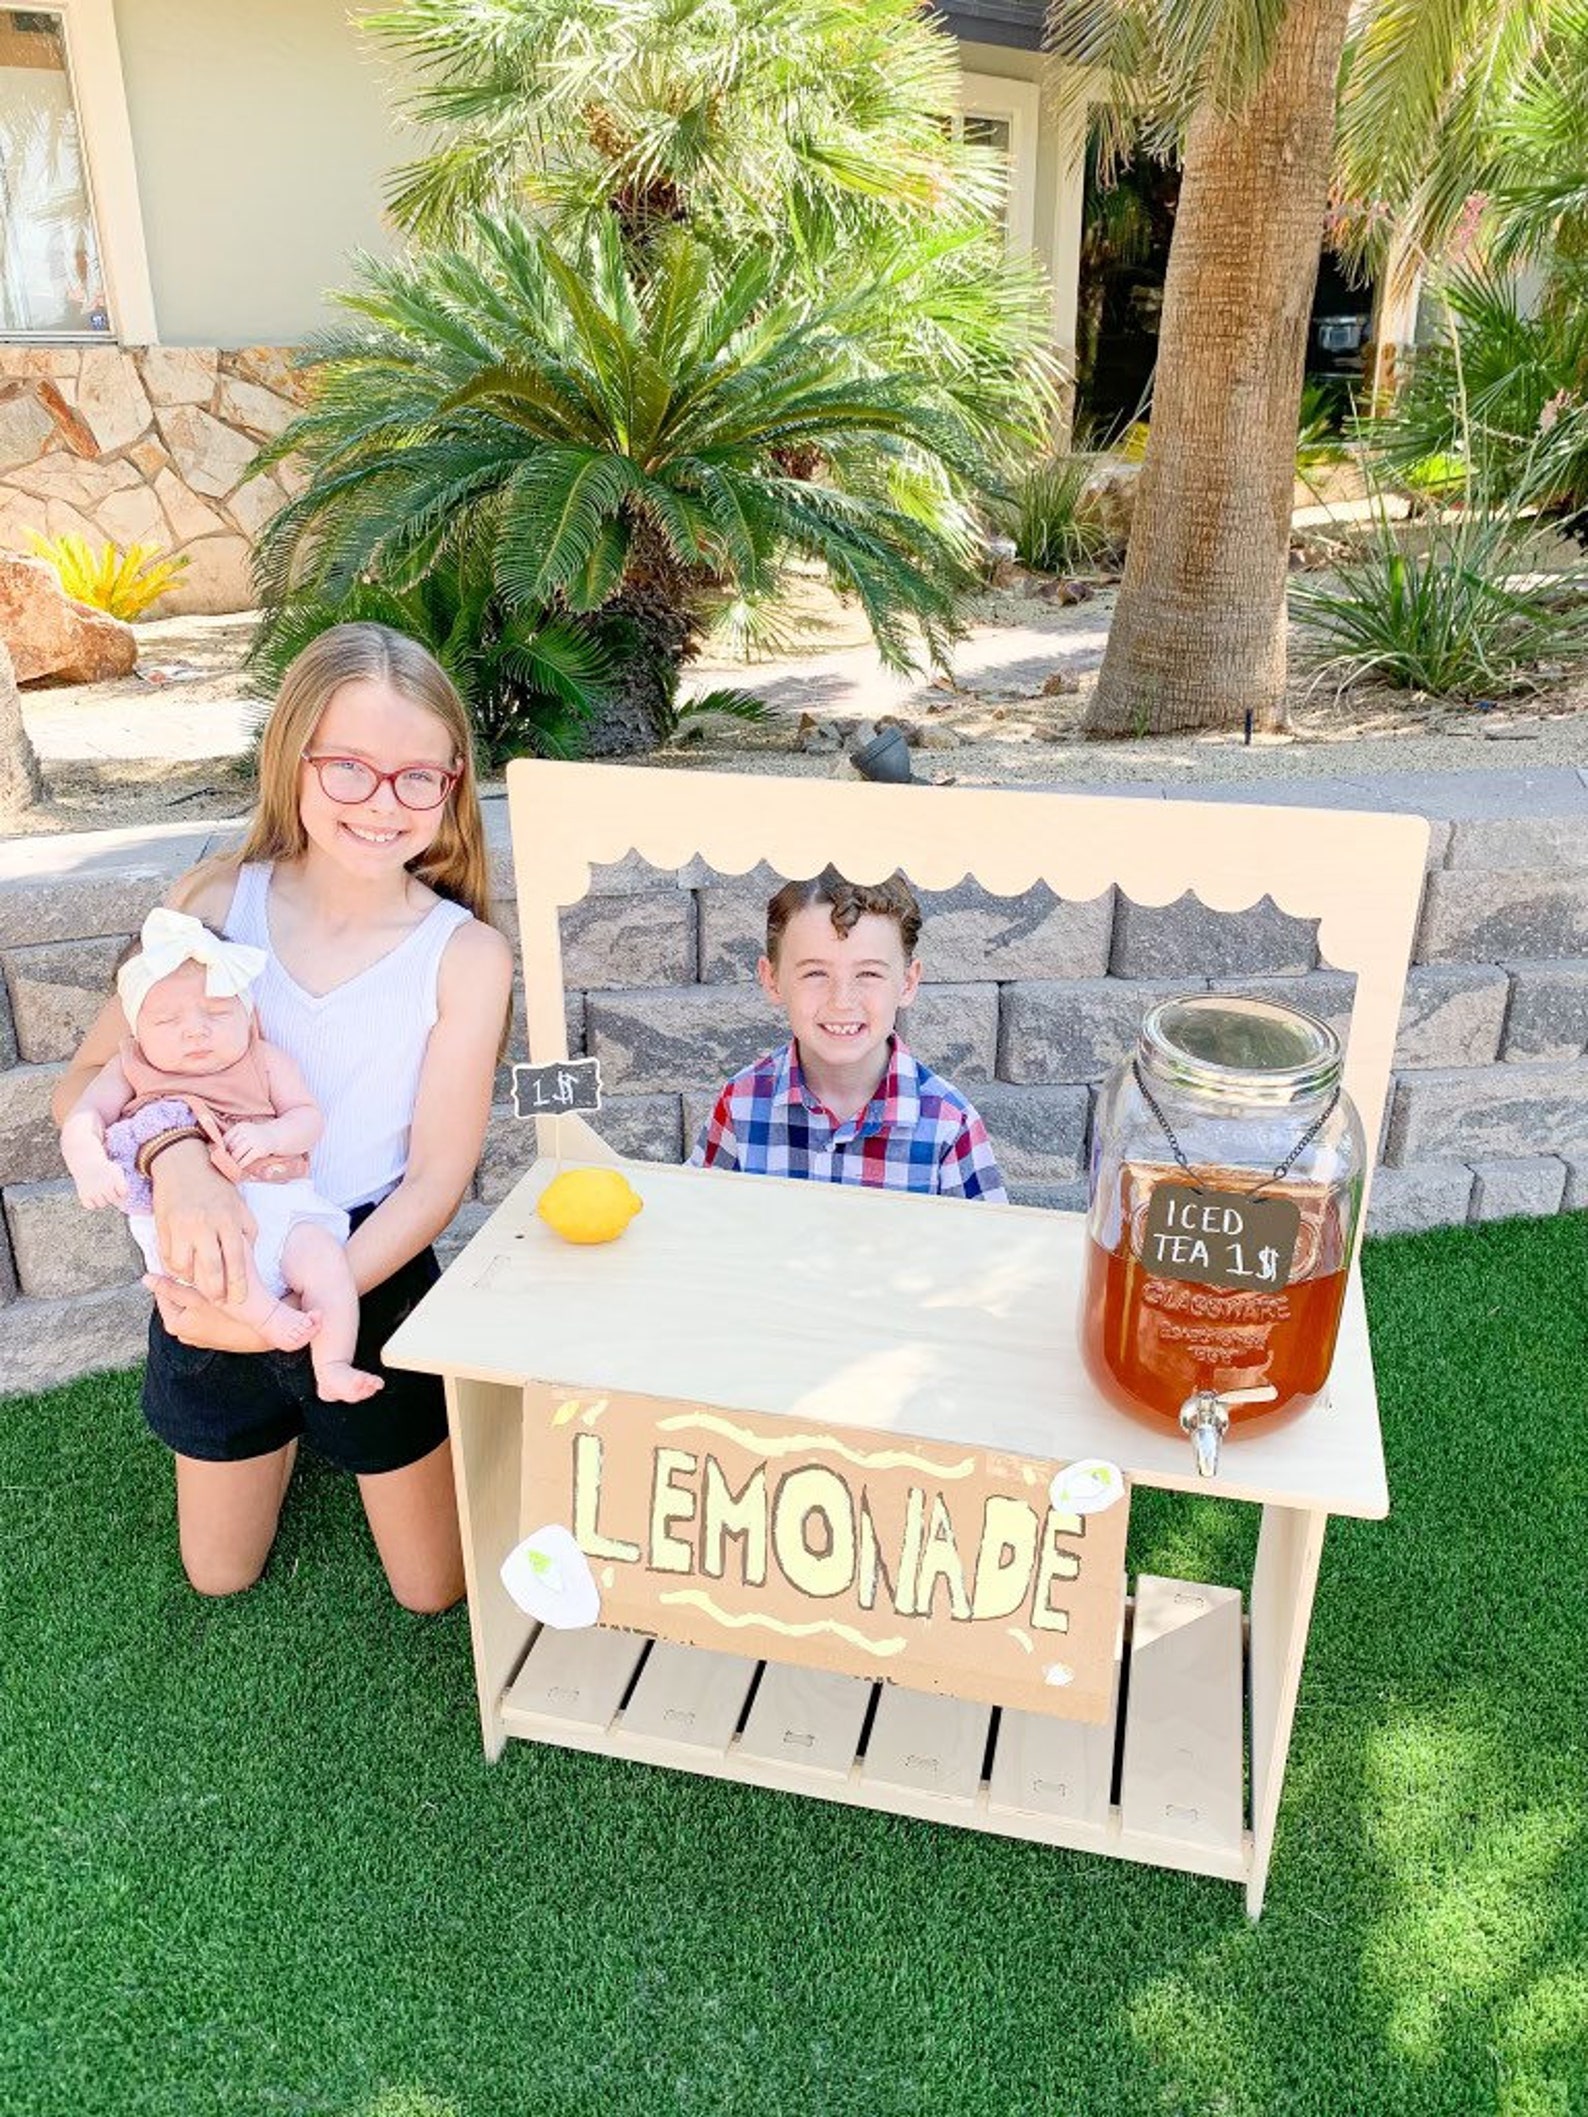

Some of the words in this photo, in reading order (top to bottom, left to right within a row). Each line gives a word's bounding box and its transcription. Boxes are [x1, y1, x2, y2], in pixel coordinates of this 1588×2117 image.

[1166, 1200, 1244, 1235] ICED
[1153, 1233, 1209, 1268] TEA
[572, 1432, 1086, 1633] LEMONADE
